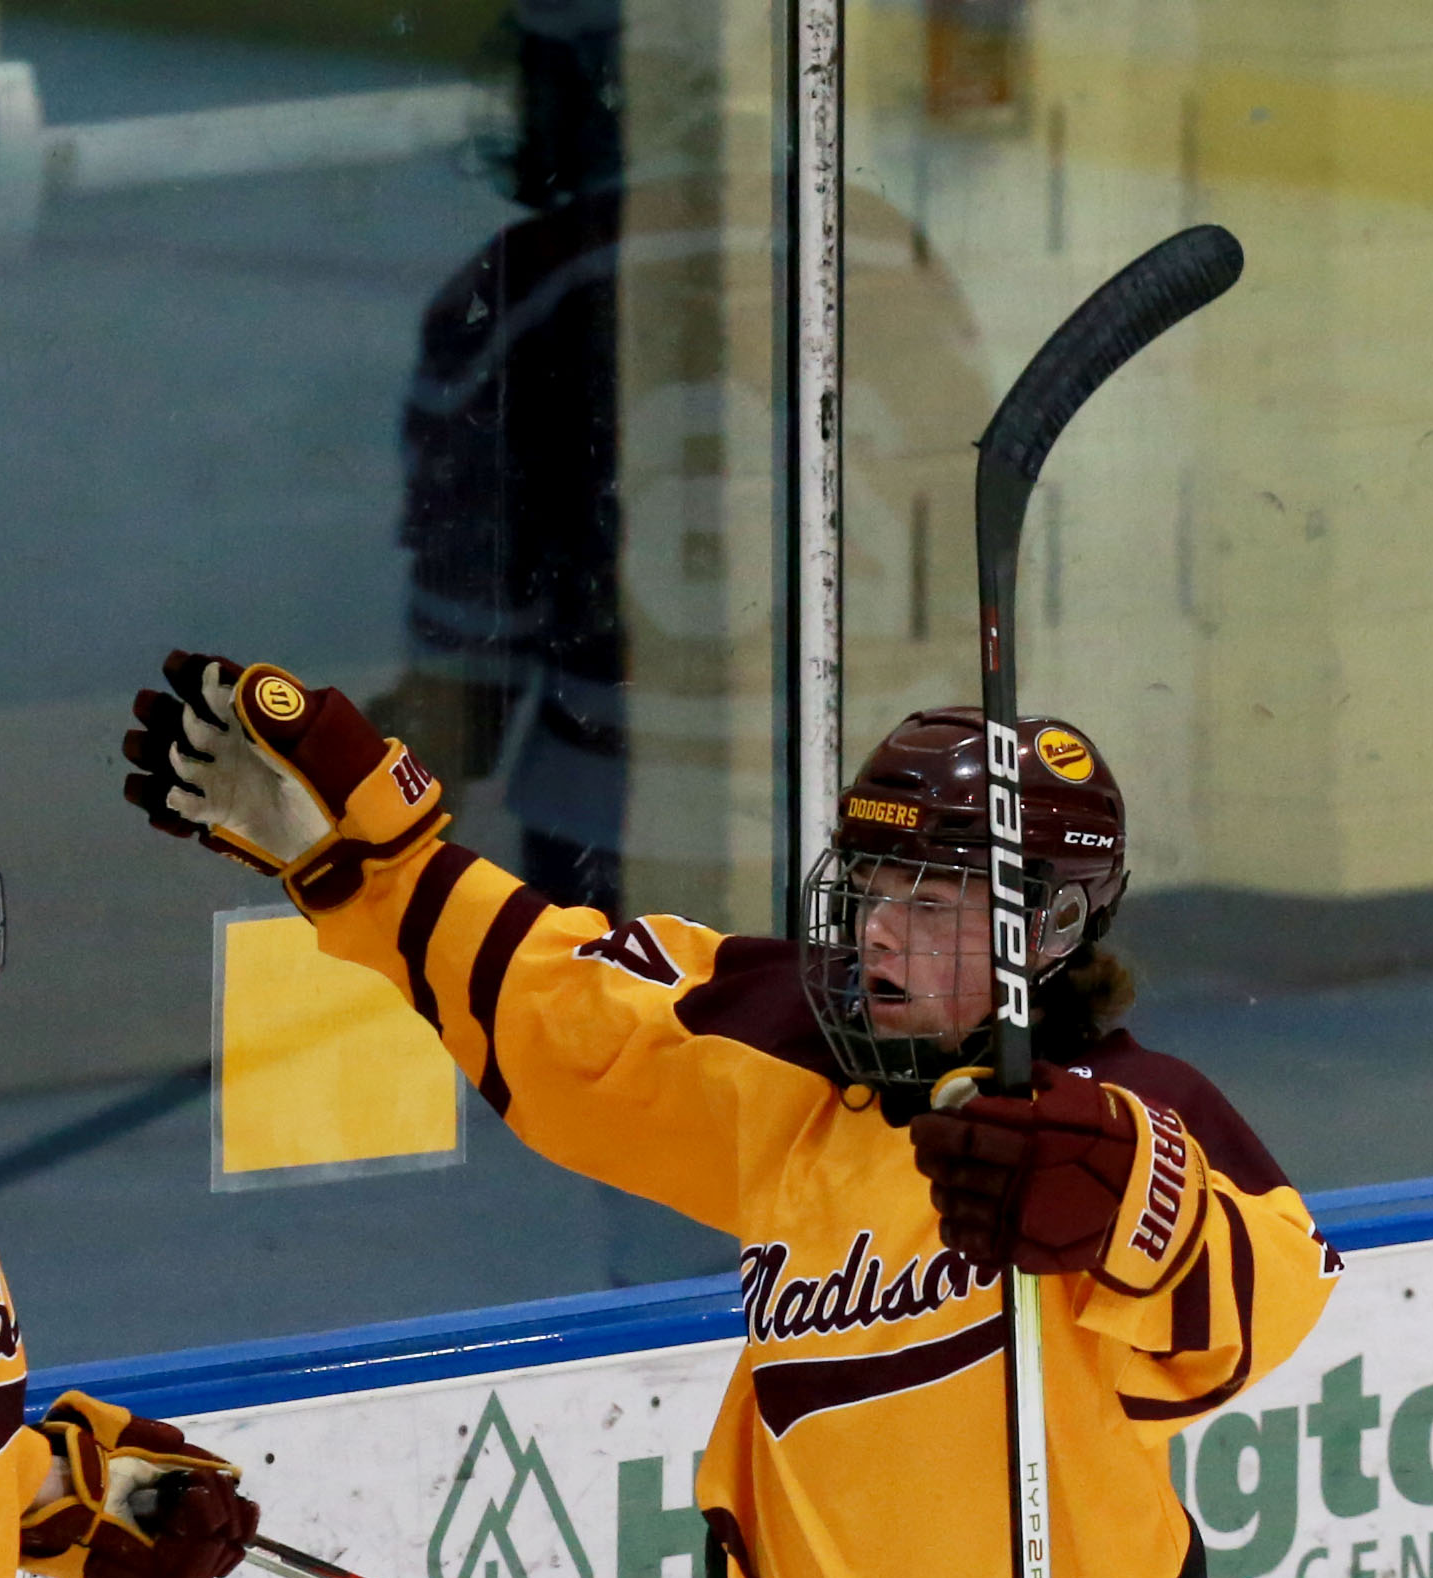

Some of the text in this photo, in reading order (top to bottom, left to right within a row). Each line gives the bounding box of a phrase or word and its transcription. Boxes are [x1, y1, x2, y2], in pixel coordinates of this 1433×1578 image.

[847, 797, 919, 828] DODGERS
[1064, 831, 1114, 848] CCM
[987, 720, 1029, 1028] BAUER
